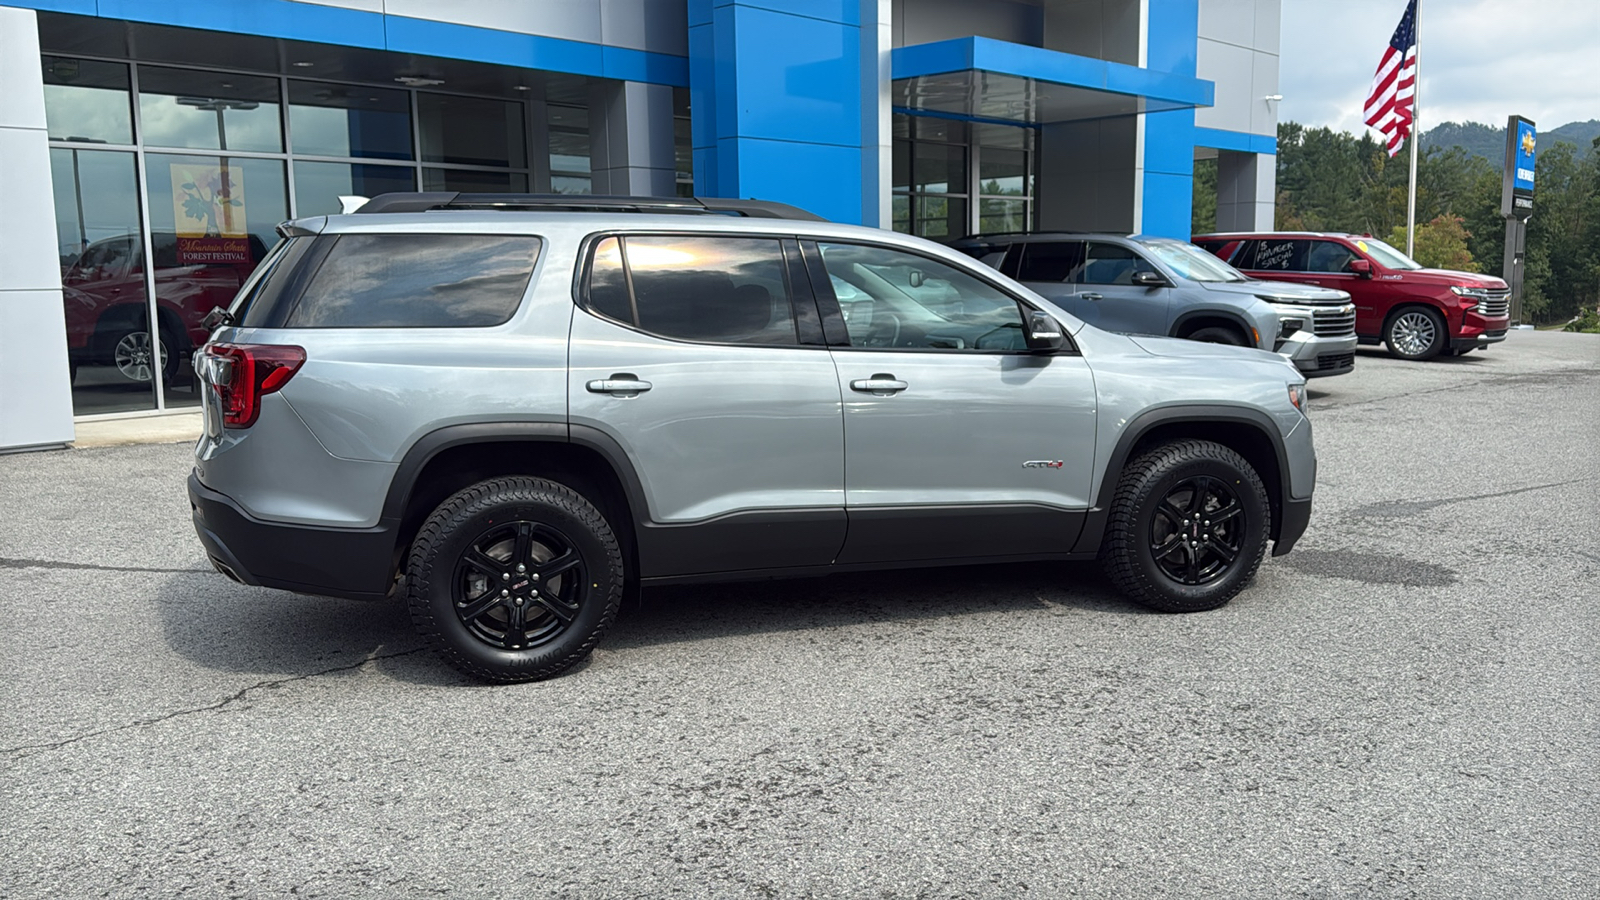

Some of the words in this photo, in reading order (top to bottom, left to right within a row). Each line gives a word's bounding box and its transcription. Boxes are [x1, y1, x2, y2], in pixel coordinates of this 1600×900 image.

[179, 239, 221, 252] Mountain
[223, 240, 247, 252] State
[1256, 242, 1294, 262] MANAGER
[183, 252, 212, 260] FOREST
[212, 252, 246, 260] FESTIVAL
[1261, 250, 1294, 269] SPECIAL
